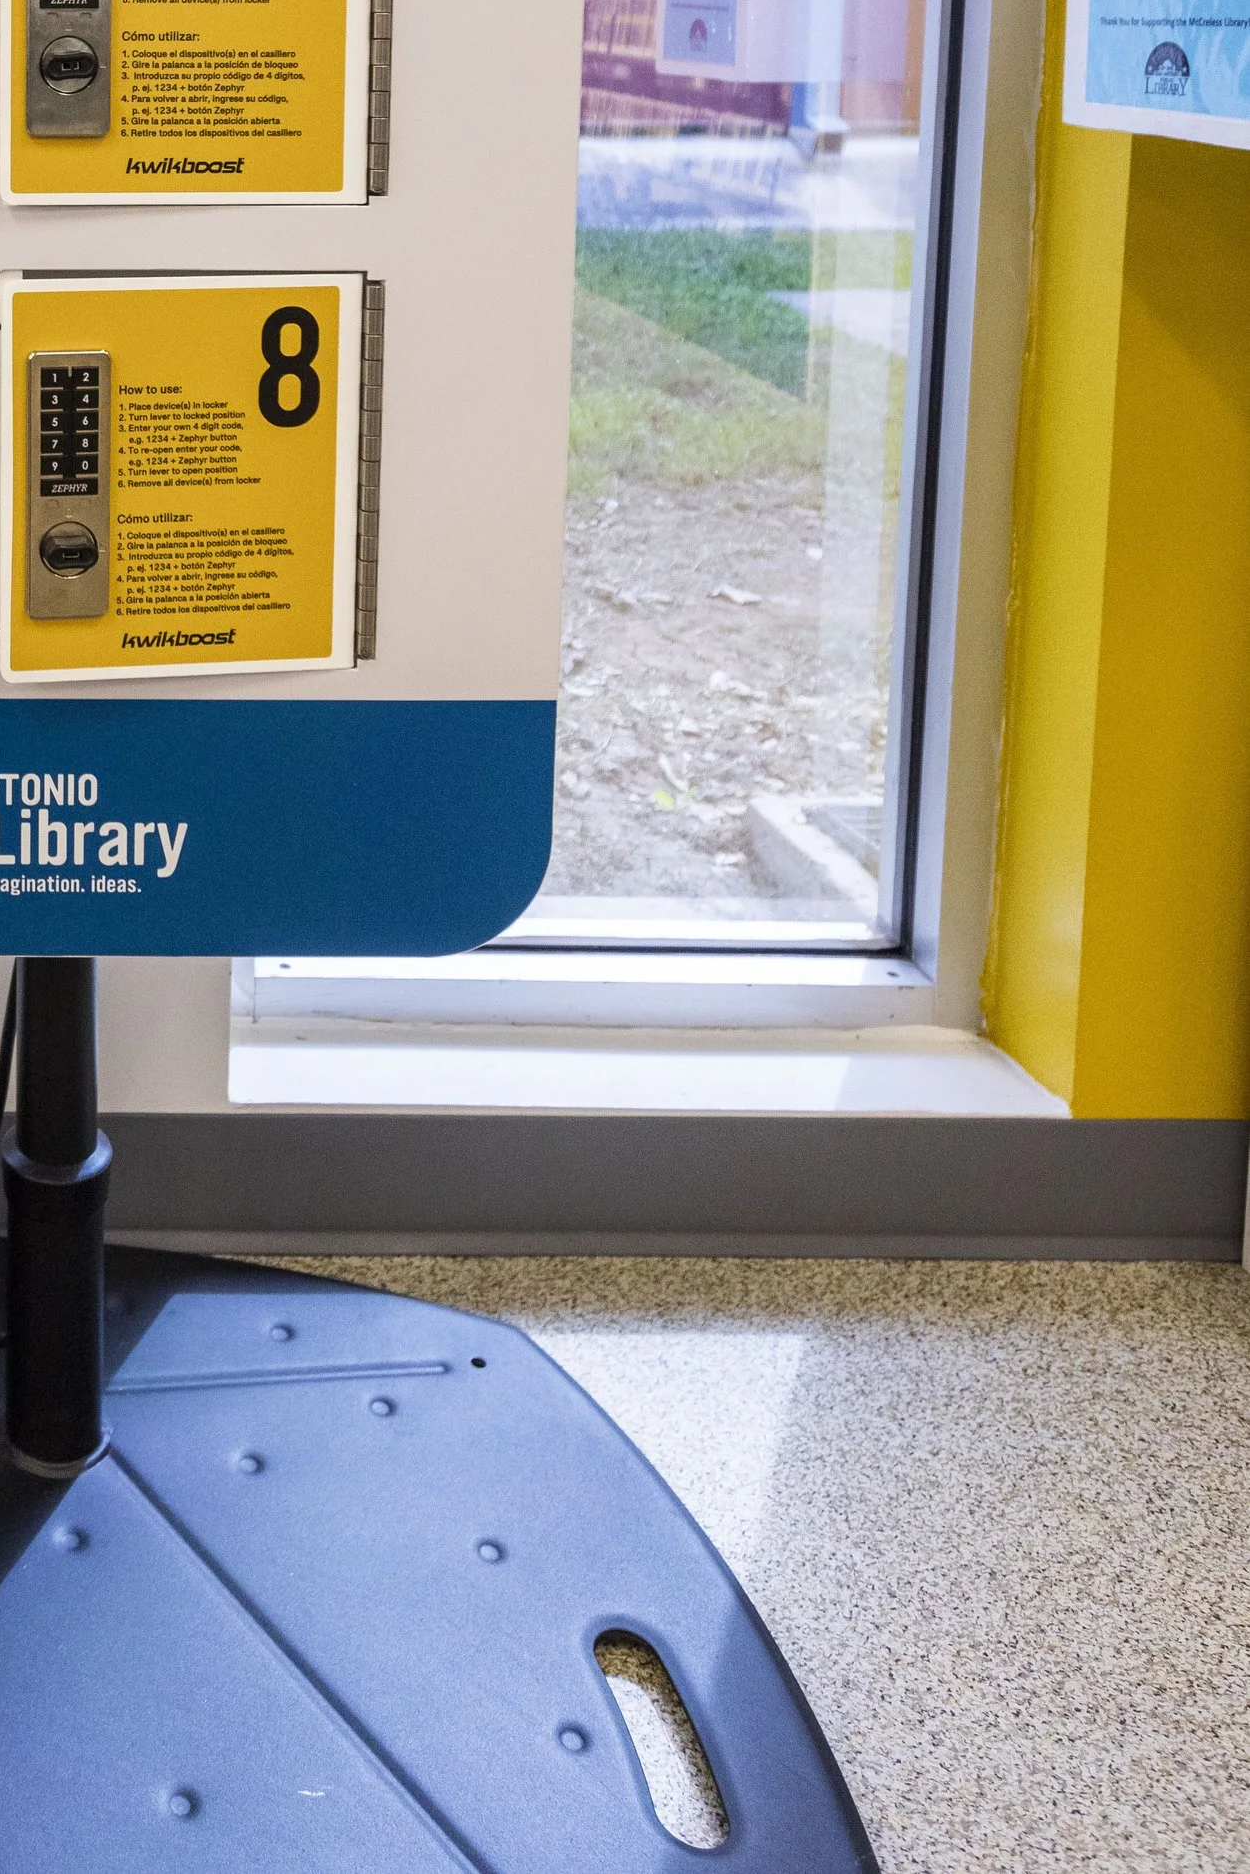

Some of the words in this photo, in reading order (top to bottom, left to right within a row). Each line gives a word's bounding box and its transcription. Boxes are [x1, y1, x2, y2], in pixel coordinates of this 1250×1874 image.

[121, 30, 156, 42] Cómo
[158, 30, 200, 42] utilizar:
[125, 157, 245, 174] kwikboost
[258, 305, 321, 428] 8
[118, 384, 144, 395] How
[145, 385, 158, 395] to
[160, 385, 183, 394] use:
[50, 483, 89, 494] ZEPHYR
[116, 513, 150, 525] Cómo
[152, 512, 193, 524] utilizar:
[121, 628, 237, 649] kwikboost
[90, 874, 142, 894] ideas.
